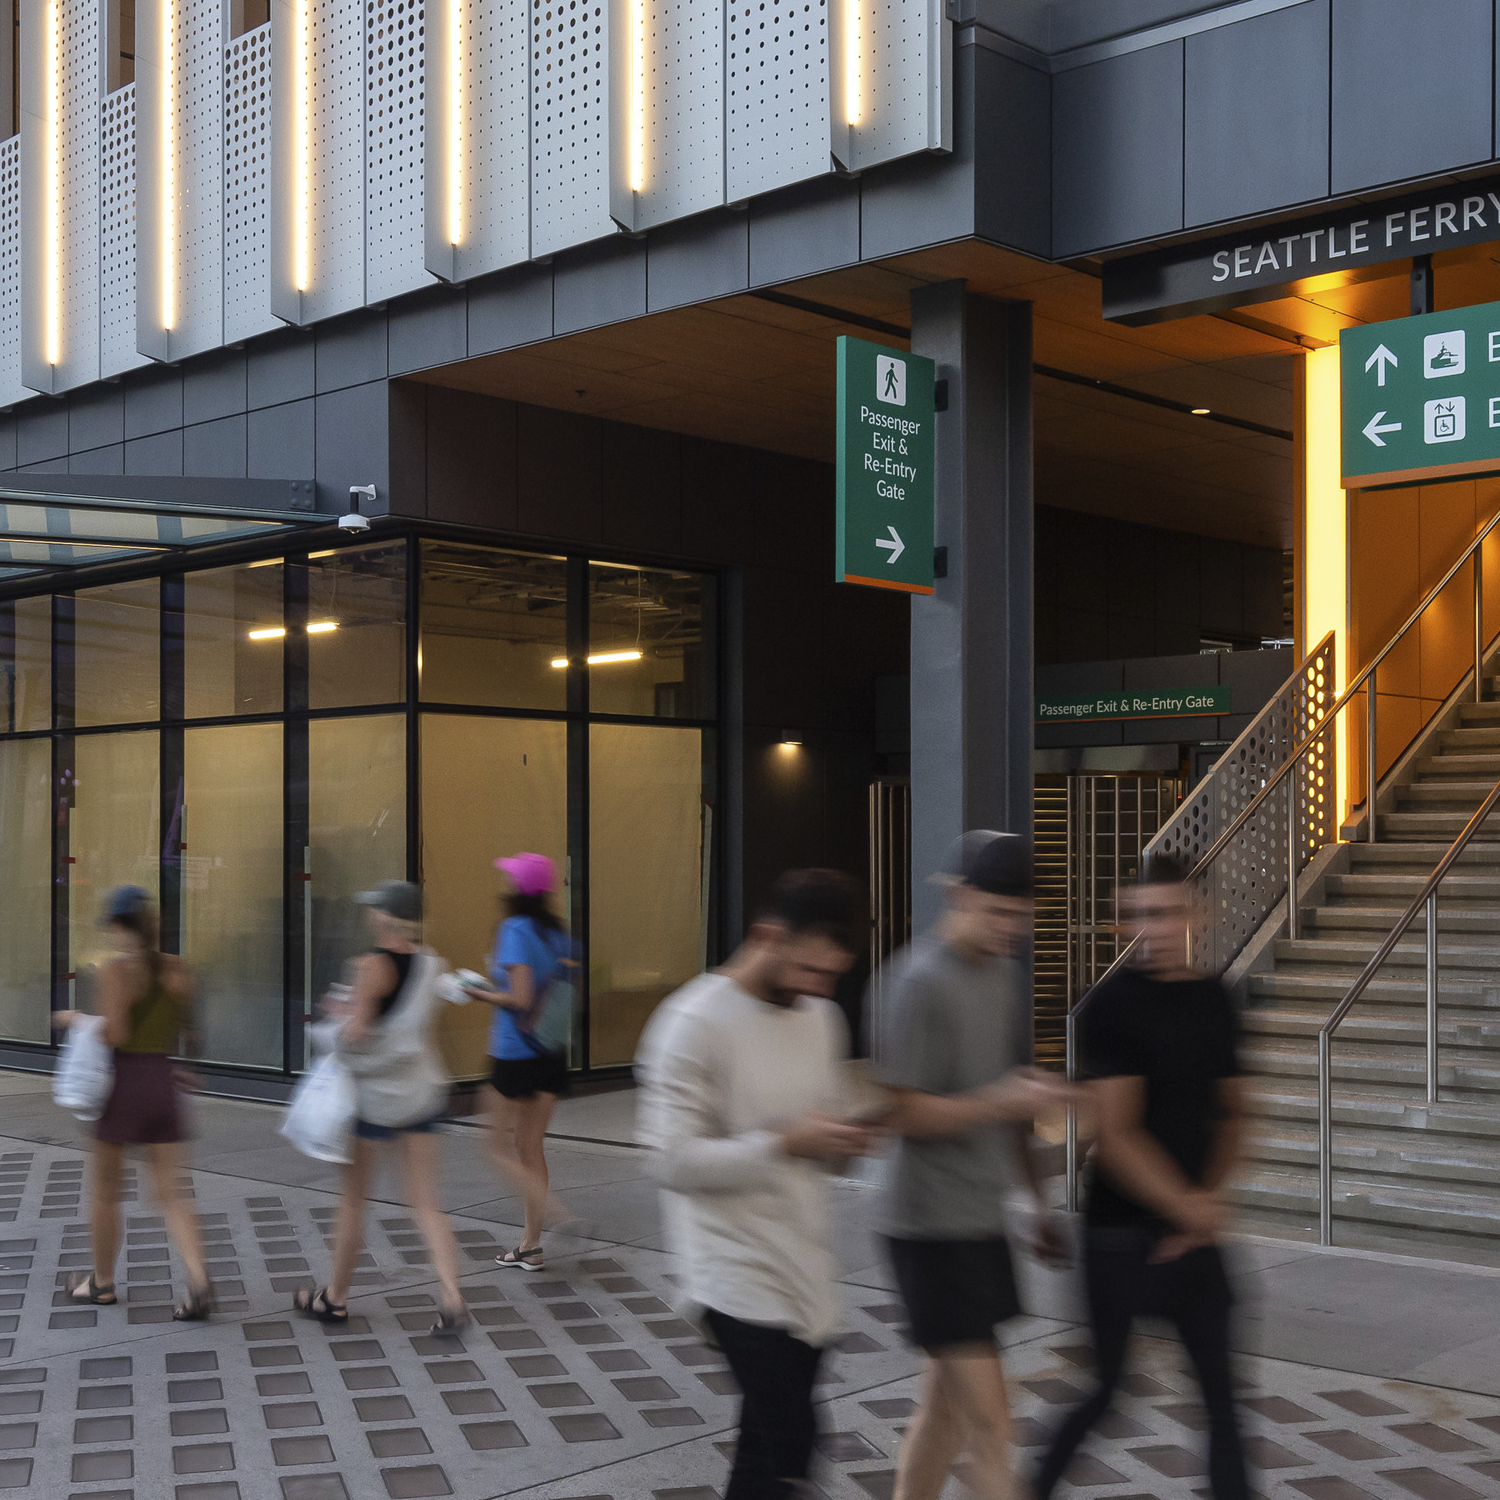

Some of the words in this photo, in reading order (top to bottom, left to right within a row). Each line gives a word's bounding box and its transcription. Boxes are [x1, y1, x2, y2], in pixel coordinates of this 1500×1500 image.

[1210, 219, 1371, 283] SEATTLE
[861, 405, 921, 436] Passenger
[873, 432, 895, 453] Exit
[898, 438, 909, 456] &
[864, 453, 917, 483] Re-Entry
[876, 479, 906, 501] Gate
[1039, 703, 1094, 717] Passenger
[1096, 700, 1118, 713] Exit
[1120, 699, 1130, 712] &
[1132, 697, 1183, 712] Re-Entry
[1185, 695, 1214, 709] Gate
